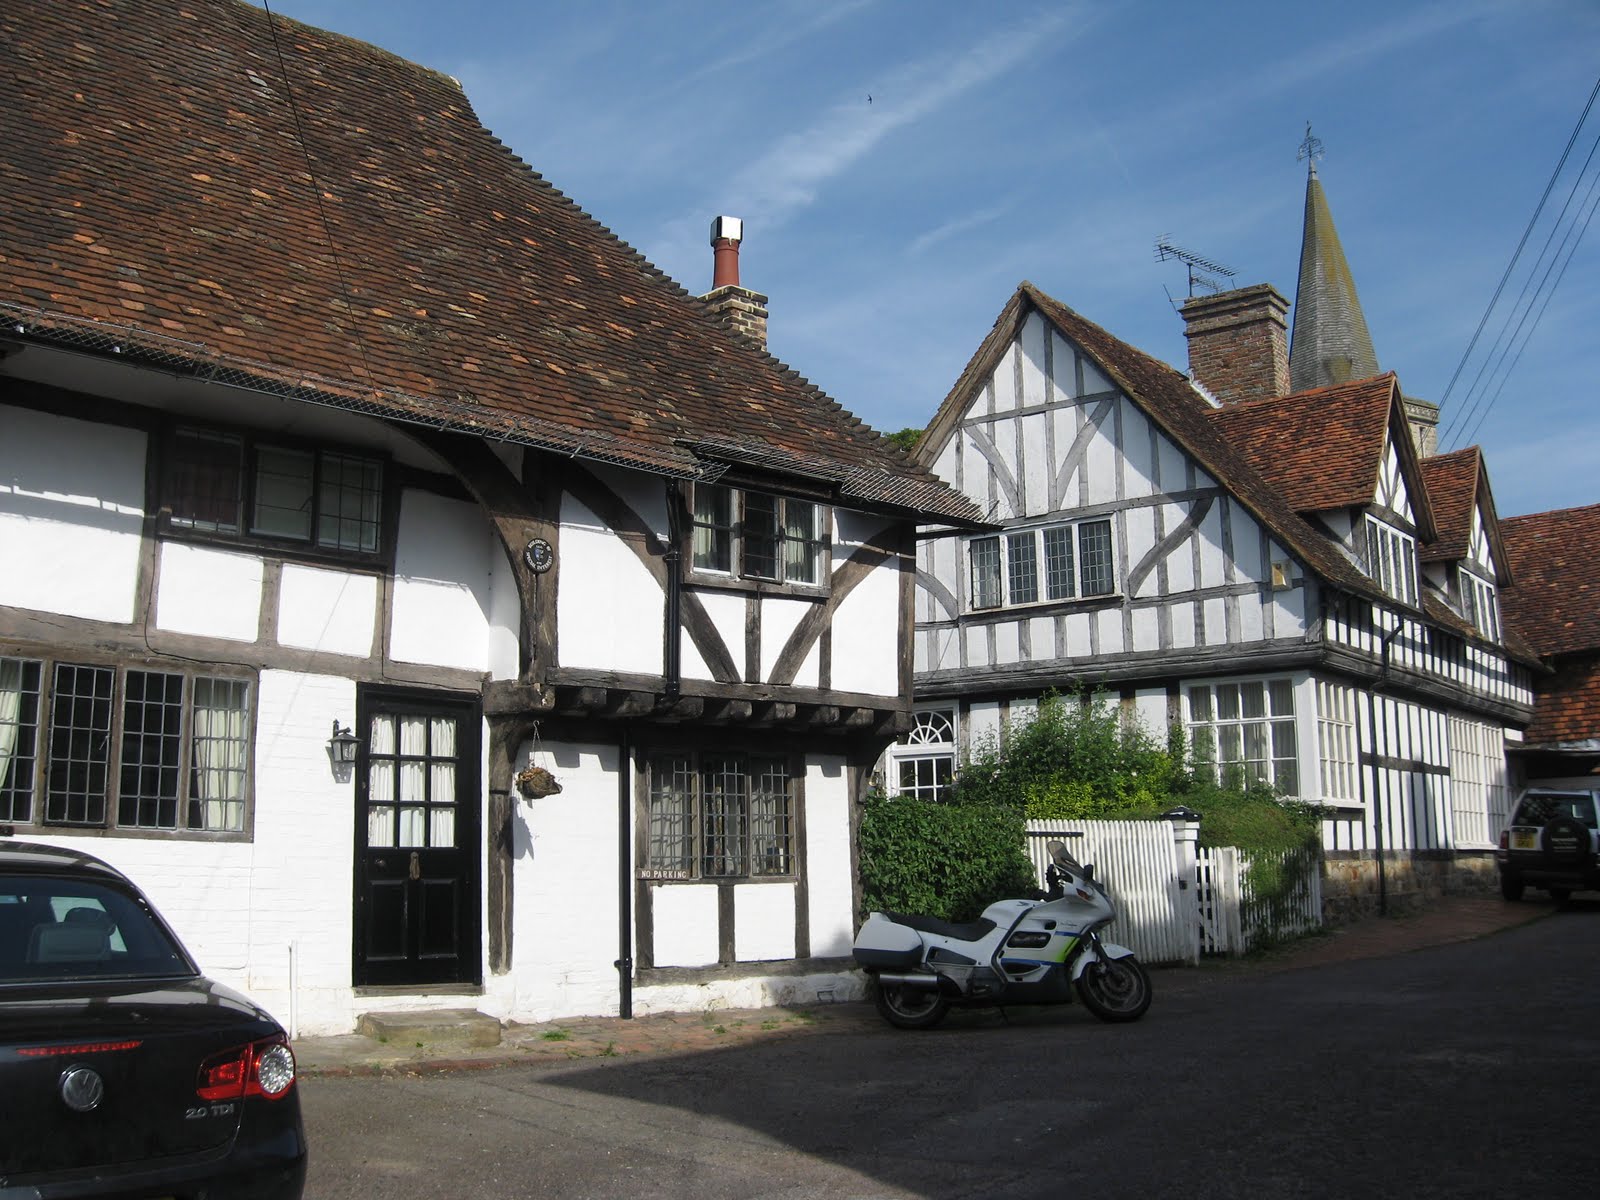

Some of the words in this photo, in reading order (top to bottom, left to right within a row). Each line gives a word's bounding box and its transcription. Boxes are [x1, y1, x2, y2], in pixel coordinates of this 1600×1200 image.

[641, 870, 651, 878] NO
[653, 870, 687, 878] PARKING
[210, 1102, 234, 1117] TDI
